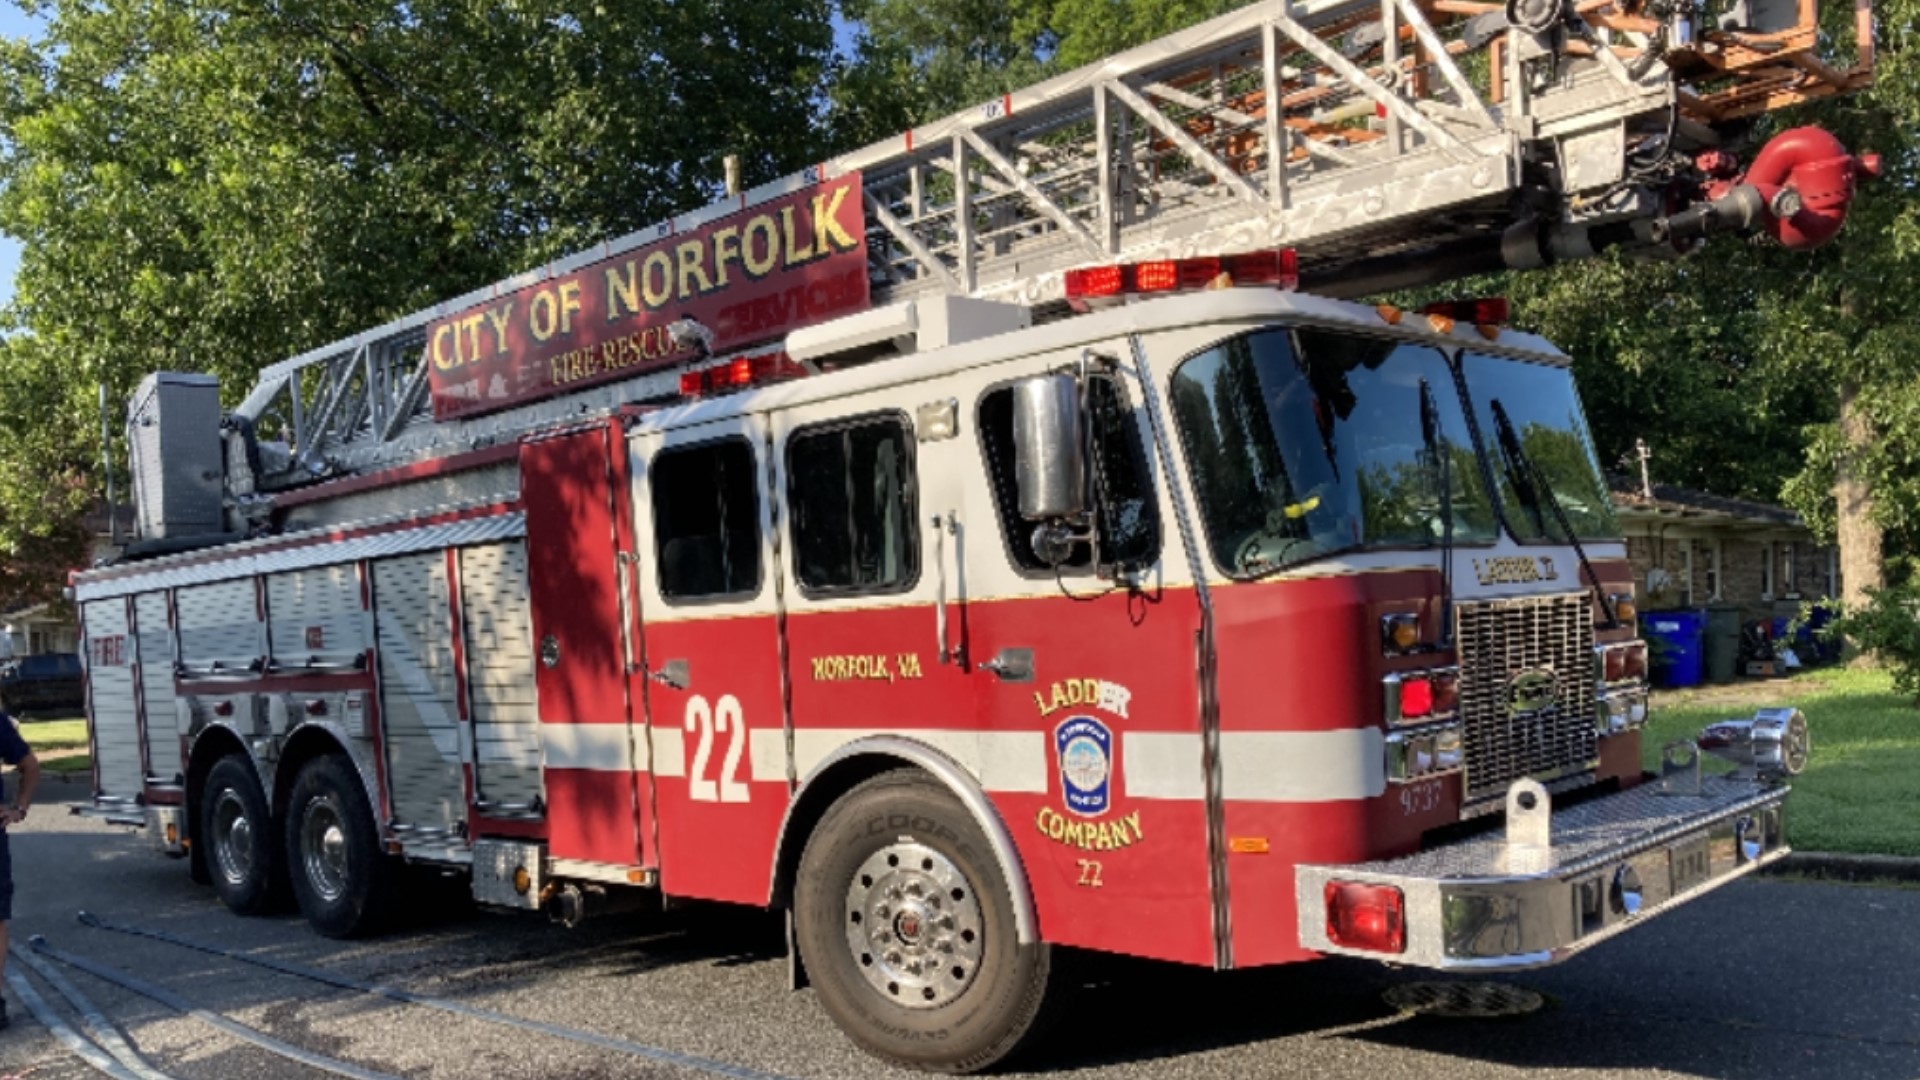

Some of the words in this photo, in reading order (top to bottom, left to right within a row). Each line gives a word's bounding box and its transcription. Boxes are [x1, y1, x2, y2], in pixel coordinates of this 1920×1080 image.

[432, 301, 515, 372] CITY
[529, 280, 582, 342] OF
[605, 185, 858, 320] NORFOLK
[550, 325, 691, 386] FIRE-RESCU
[897, 653, 923, 678] VA
[1034, 678, 1132, 720] LADDER
[685, 694, 750, 803] 22
[1036, 806, 1143, 850] COMPANY
[1076, 858, 1104, 887] 22
